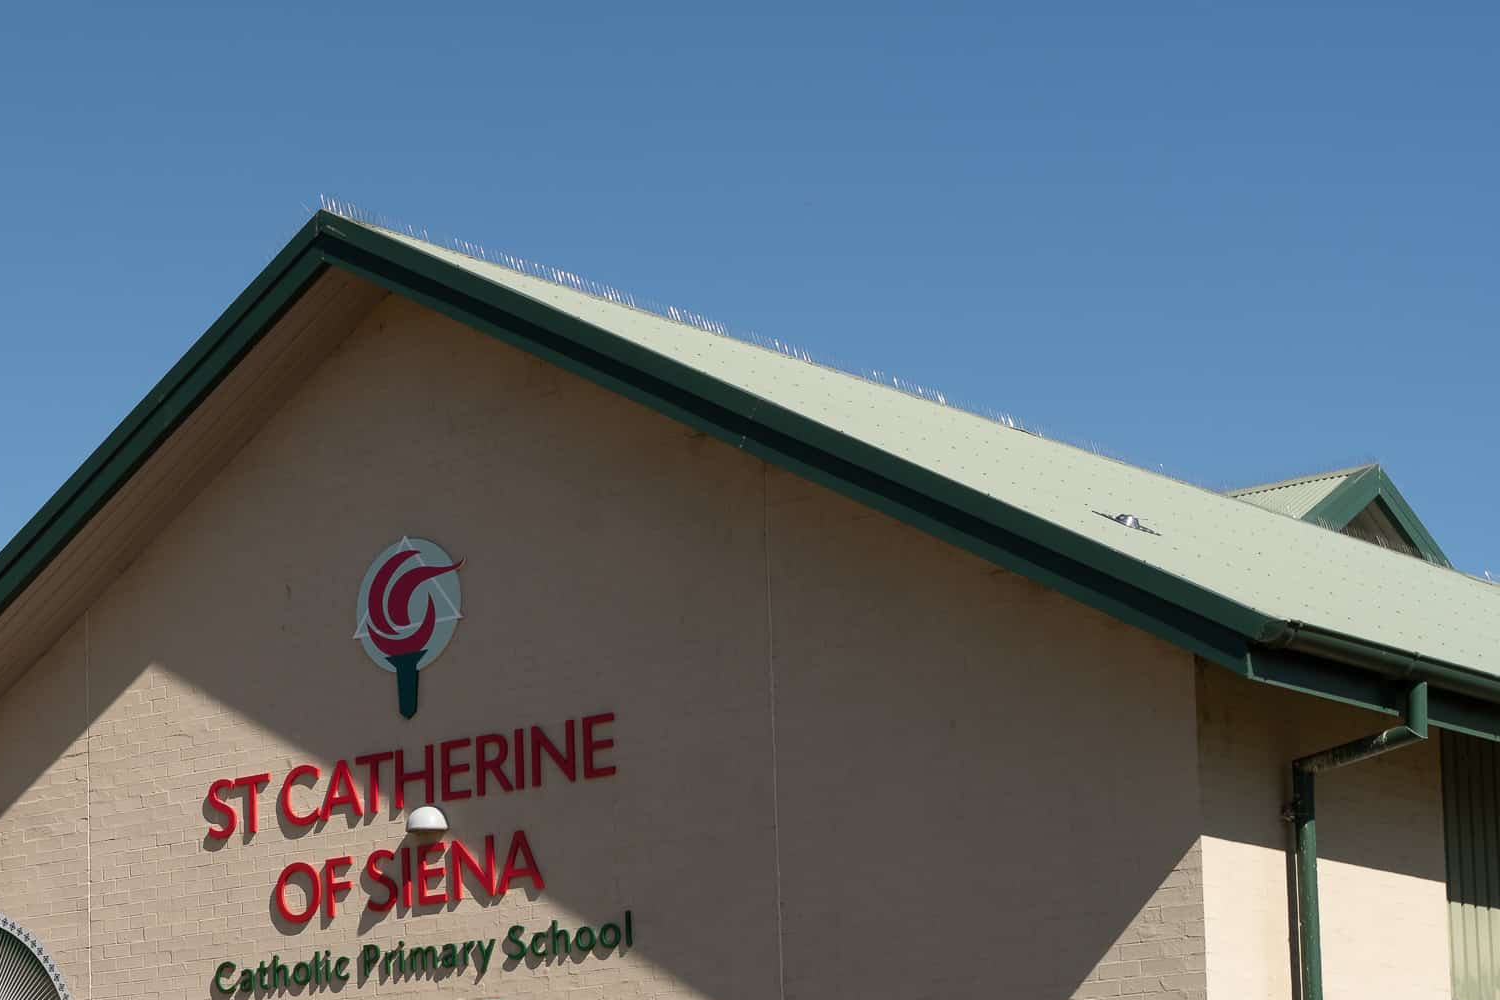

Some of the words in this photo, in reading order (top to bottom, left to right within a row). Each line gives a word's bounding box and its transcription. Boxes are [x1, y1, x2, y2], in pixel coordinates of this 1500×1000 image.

[208, 772, 271, 839] ST
[280, 712, 617, 827] CATHERINE
[275, 855, 353, 924] OF
[366, 830, 545, 912] SIENA
[214, 950, 350, 994] Catholic
[363, 938, 495, 976] Primary
[507, 910, 632, 961] School
